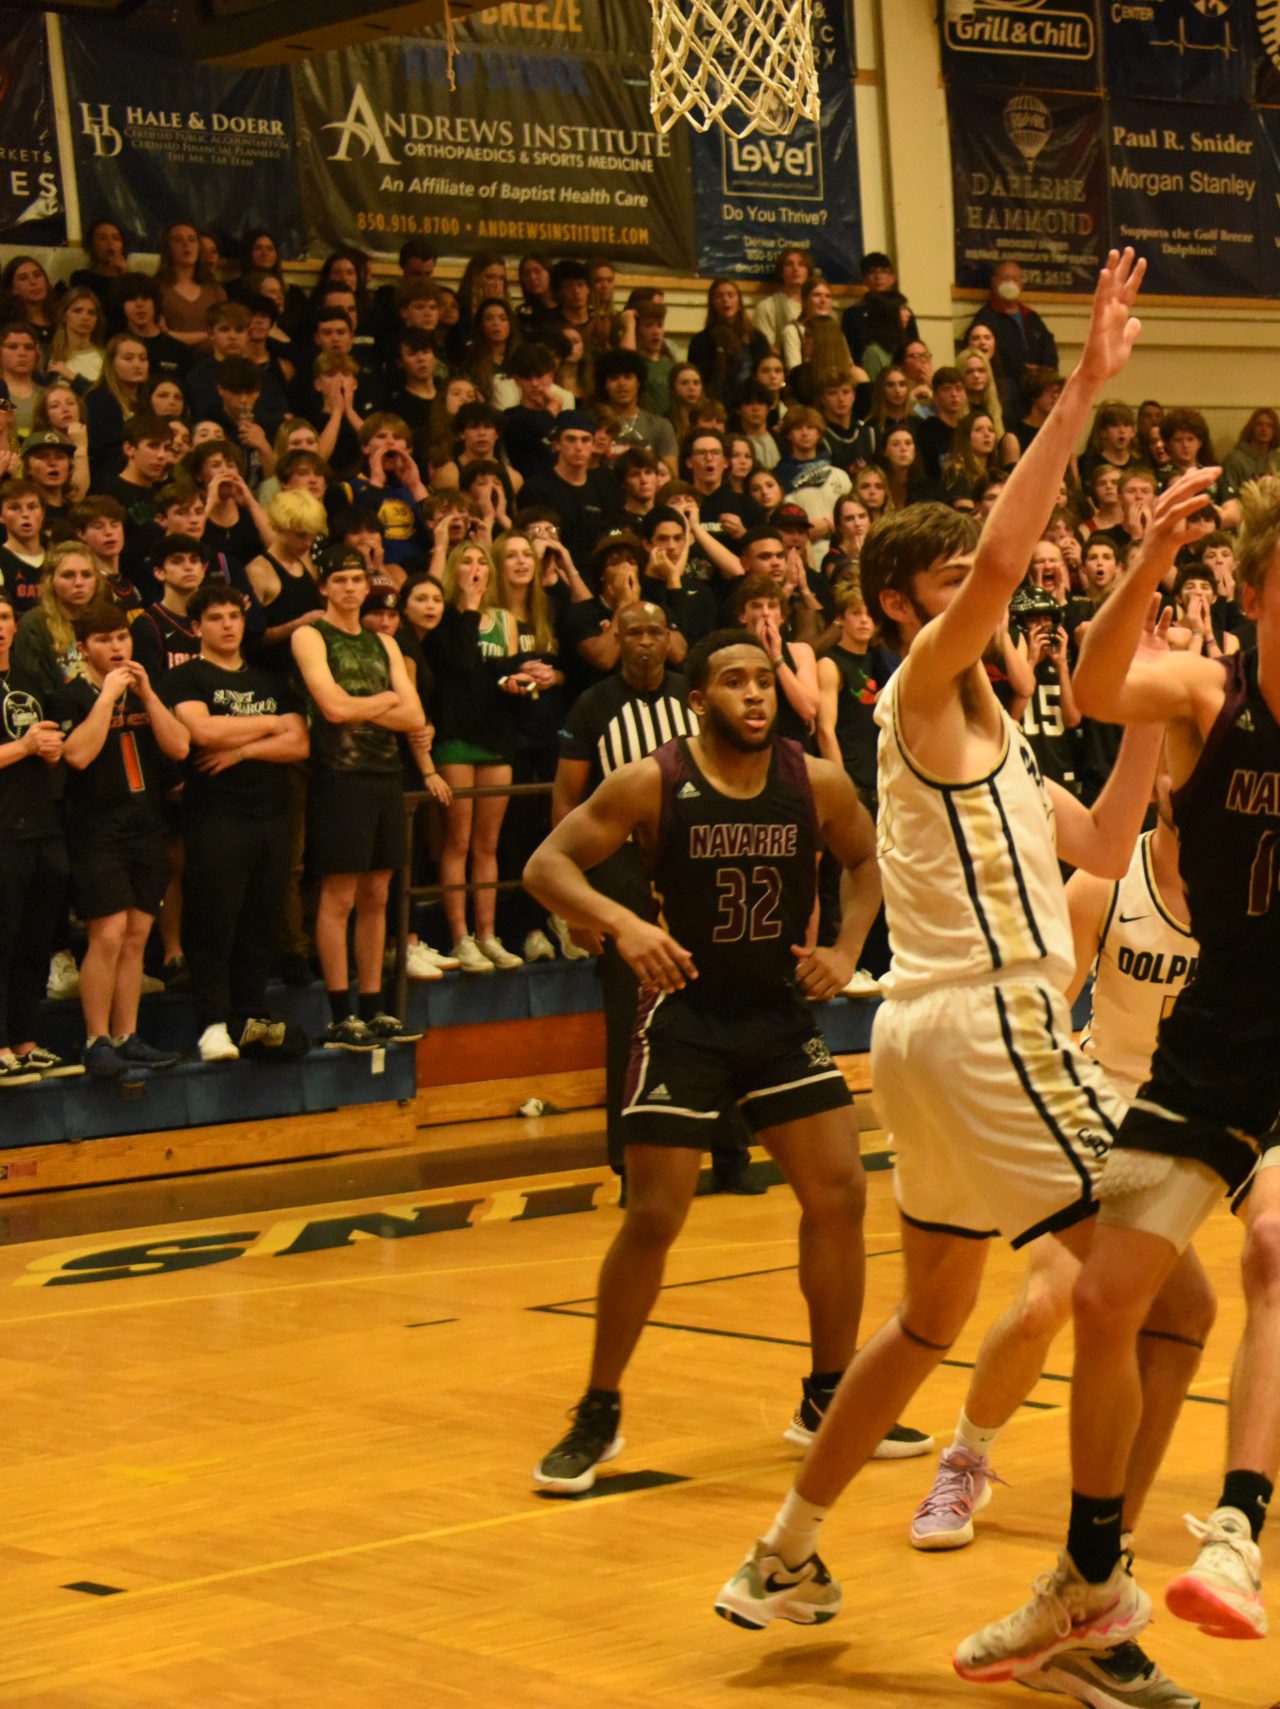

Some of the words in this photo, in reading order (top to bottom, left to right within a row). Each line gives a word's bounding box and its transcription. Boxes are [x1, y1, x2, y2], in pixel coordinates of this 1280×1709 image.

[126, 106, 182, 128] HALE
[187, 111, 206, 130] &
[211, 113, 285, 136] DOERR
[523, 121, 672, 158] INSTITUTE
[1112, 126, 1158, 149] Paul
[1163, 130, 1185, 150] R.
[1190, 132, 1254, 155] Snider
[404, 142, 516, 164] ORTHOPAEDICS
[533, 151, 585, 168] SPORTS
[587, 155, 655, 173] MEDICINE
[380, 174, 404, 193] An
[408, 176, 475, 198] Affiliate
[478, 181, 498, 199] of
[500, 183, 556, 205] Baptist
[558, 186, 611, 206] Health
[614, 189, 649, 208] Care
[1109, 166, 1184, 197] Morgan
[1189, 170, 1256, 202] Stanley
[723, 203, 744, 221] Do
[747, 205, 776, 223] You
[779, 206, 828, 226] Thrive?
[966, 204, 1095, 236] HAMMOND
[478, 218, 650, 246] ANDREWSINSTITUTE.COM
[690, 822, 798, 858] NAVARRE
[711, 864, 783, 943] 32
